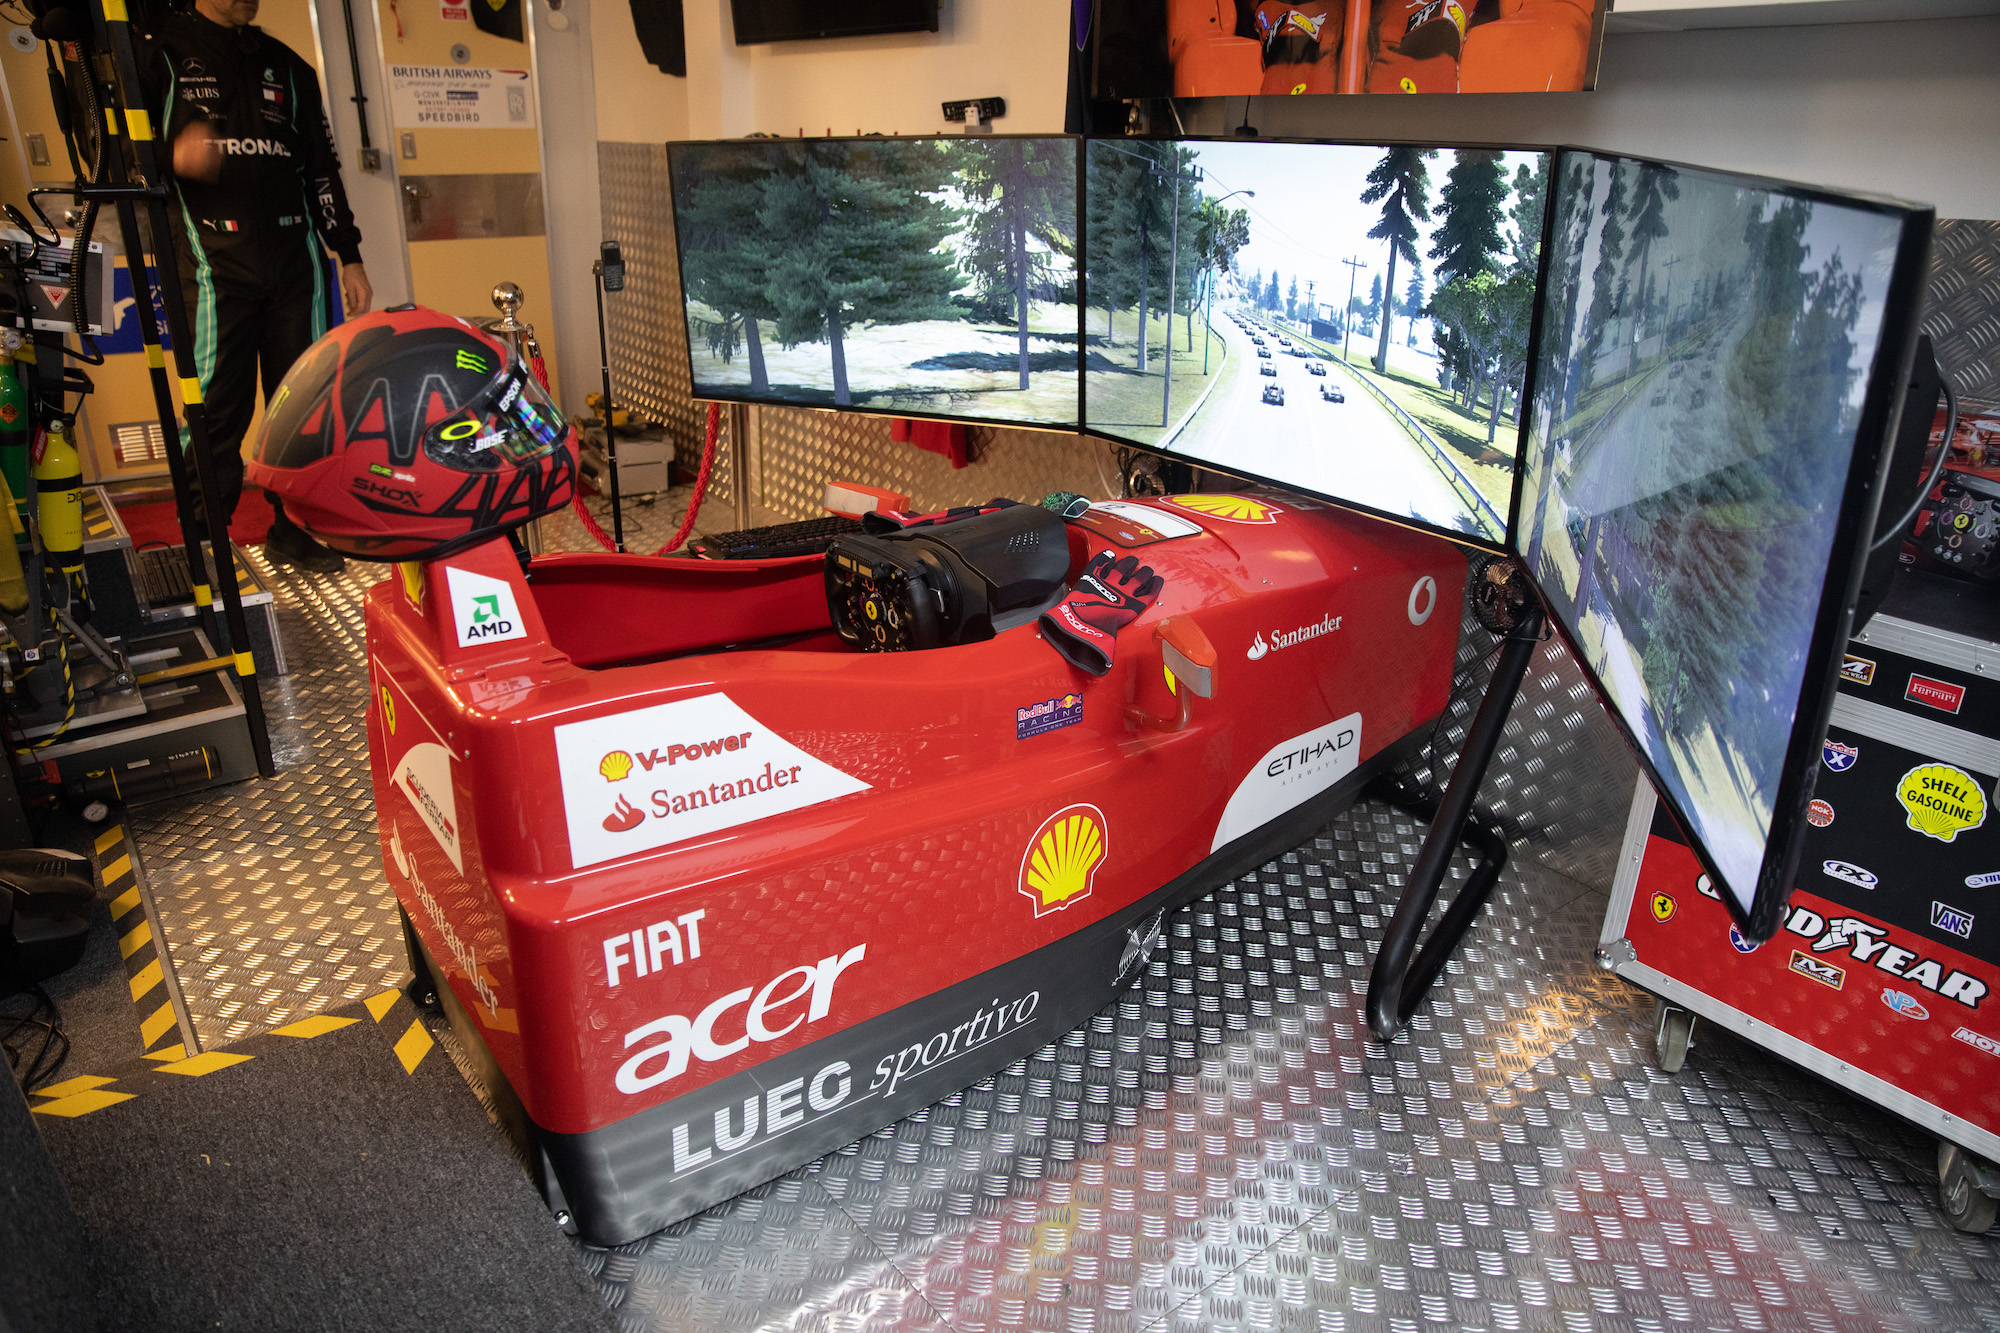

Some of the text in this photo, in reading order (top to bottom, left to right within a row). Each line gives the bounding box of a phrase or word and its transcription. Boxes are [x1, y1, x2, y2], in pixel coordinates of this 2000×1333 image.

[393, 66, 492, 80] BRITISH AIRWAYS
[196, 88, 220, 98] UBS
[418, 113, 480, 122] SPEEDBIRD
[499, 378, 521, 412] EPSON
[471, 429, 508, 453] BOSE
[1080, 574, 1118, 602] sparco
[467, 621, 512, 640] AMD
[1058, 604, 1103, 638] sparco
[1271, 612, 1342, 651] Santander
[1912, 682, 1957, 704] Ferrari
[1018, 700, 1054, 721] Red Bull
[1018, 706, 1082, 730] RACING
[635, 731, 752, 772] V-Power
[1267, 729, 1354, 778] ETIHAD
[1824, 741, 1857, 756] RACER
[1828, 751, 1848, 768] X
[1281, 758, 1339, 787] AIRWAYS
[406, 766, 445, 821] SCUDERIA
[650, 762, 801, 820] Santander
[1921, 777, 1969, 803] SHELL
[1811, 804, 1830, 816] NGK
[1906, 790, 1974, 822] GASOLINE
[419, 796, 454, 847] FERRARI
[1834, 865, 1865, 882] FX
[1932, 902, 1975, 937] VANS
[409, 851, 499, 1022] Santander
[602, 908, 705, 988] FIAT
[1852, 933, 1987, 1007] YEAR
[1887, 991, 1915, 1010] VP
[614, 943, 867, 1095] acer
[672, 990, 1040, 1174] LUEG sportivo
